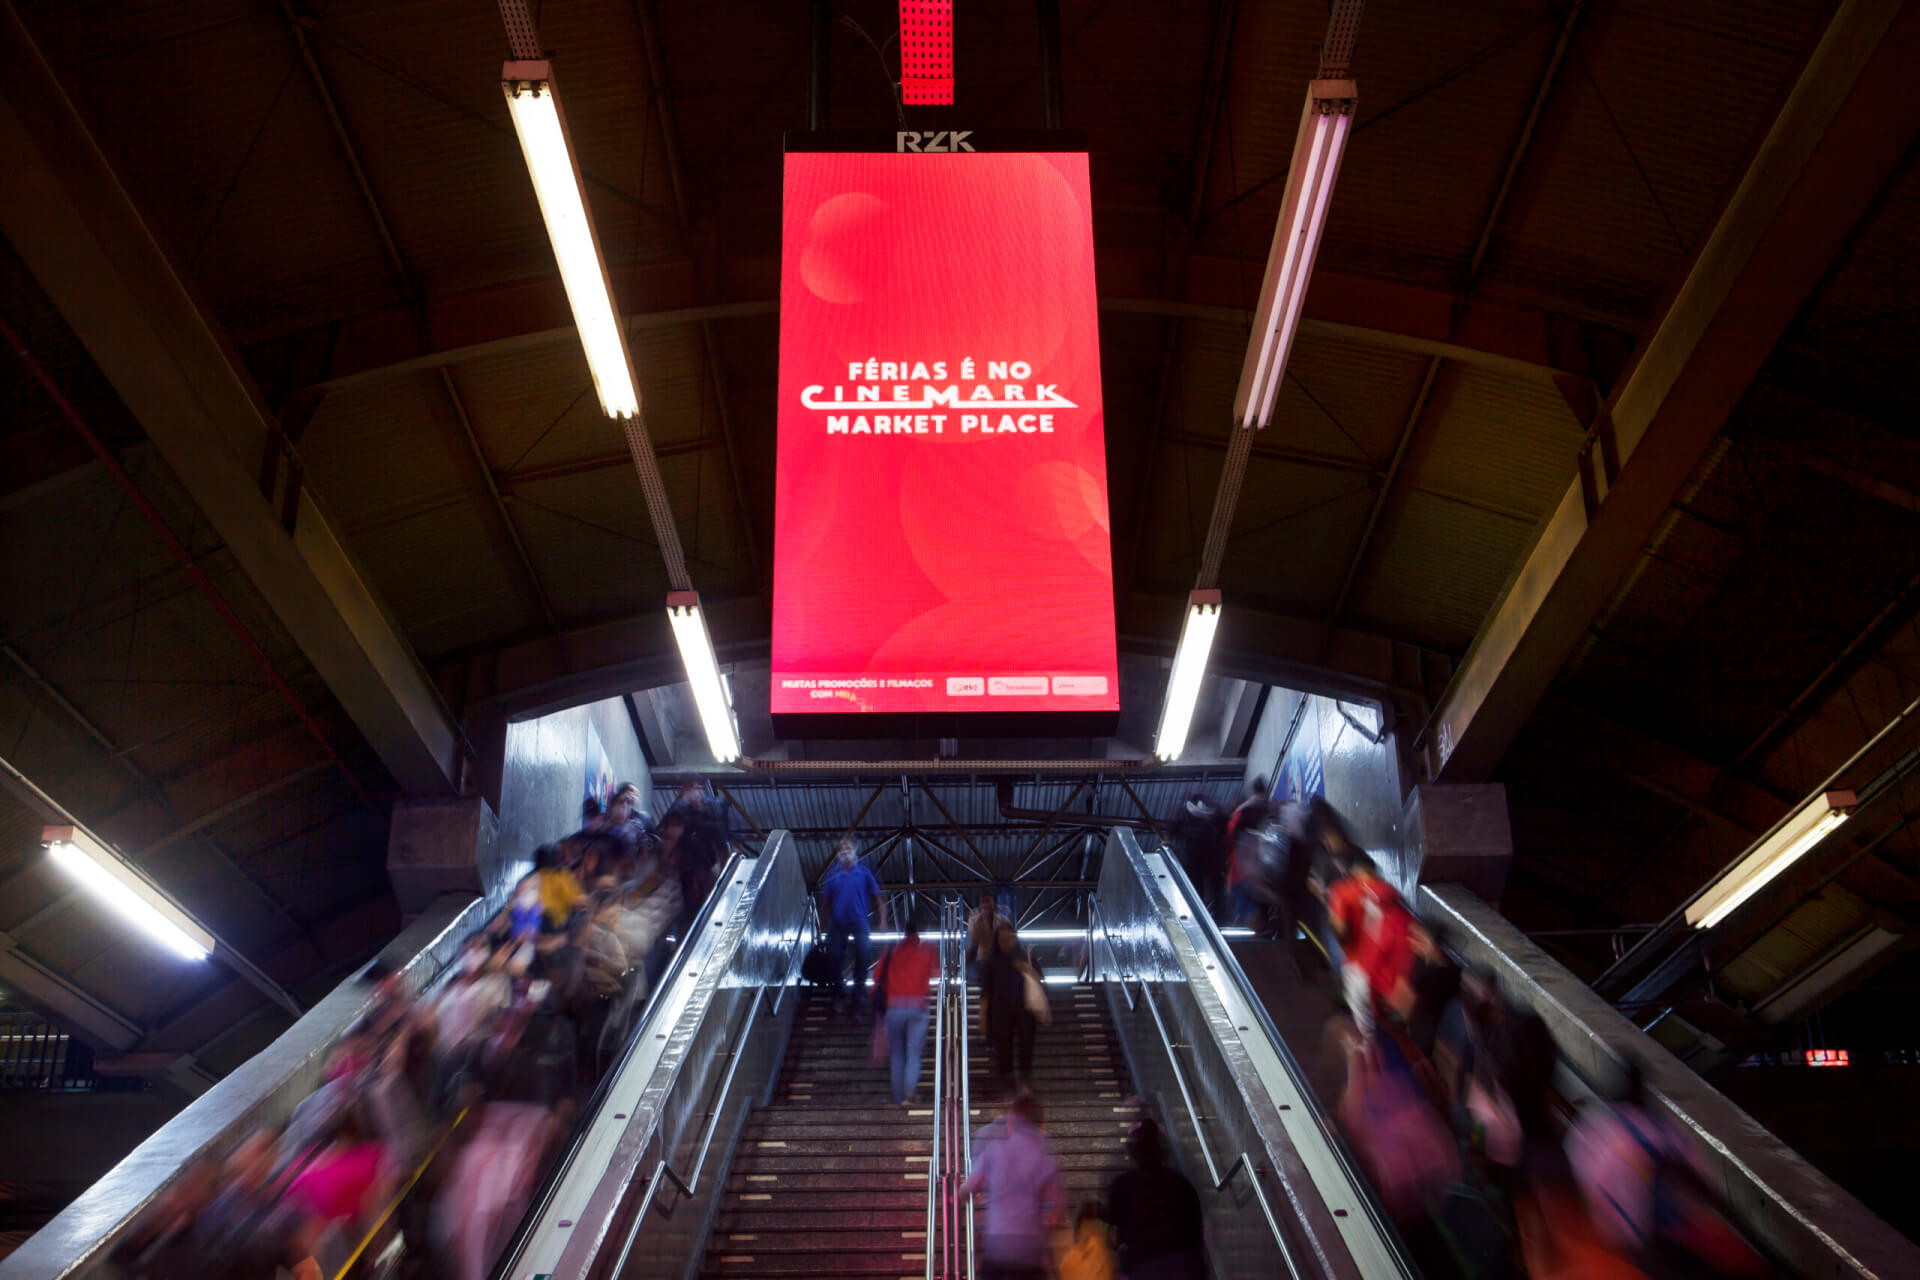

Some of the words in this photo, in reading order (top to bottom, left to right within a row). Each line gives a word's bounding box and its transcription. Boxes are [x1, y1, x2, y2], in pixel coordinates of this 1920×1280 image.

[896, 131, 976, 152] RZK
[848, 357, 948, 380] FÉRIAS
[960, 356, 975, 380] É
[988, 361, 1032, 380] NO
[800, 384, 1079, 410] CINEMARK
[826, 415, 948, 434] MARKET
[960, 414, 1055, 433] PLACE
[782, 679, 816, 689] MUITAS
[818, 677, 878, 690] PROMOÇÕES
[810, 690, 834, 698] COM
